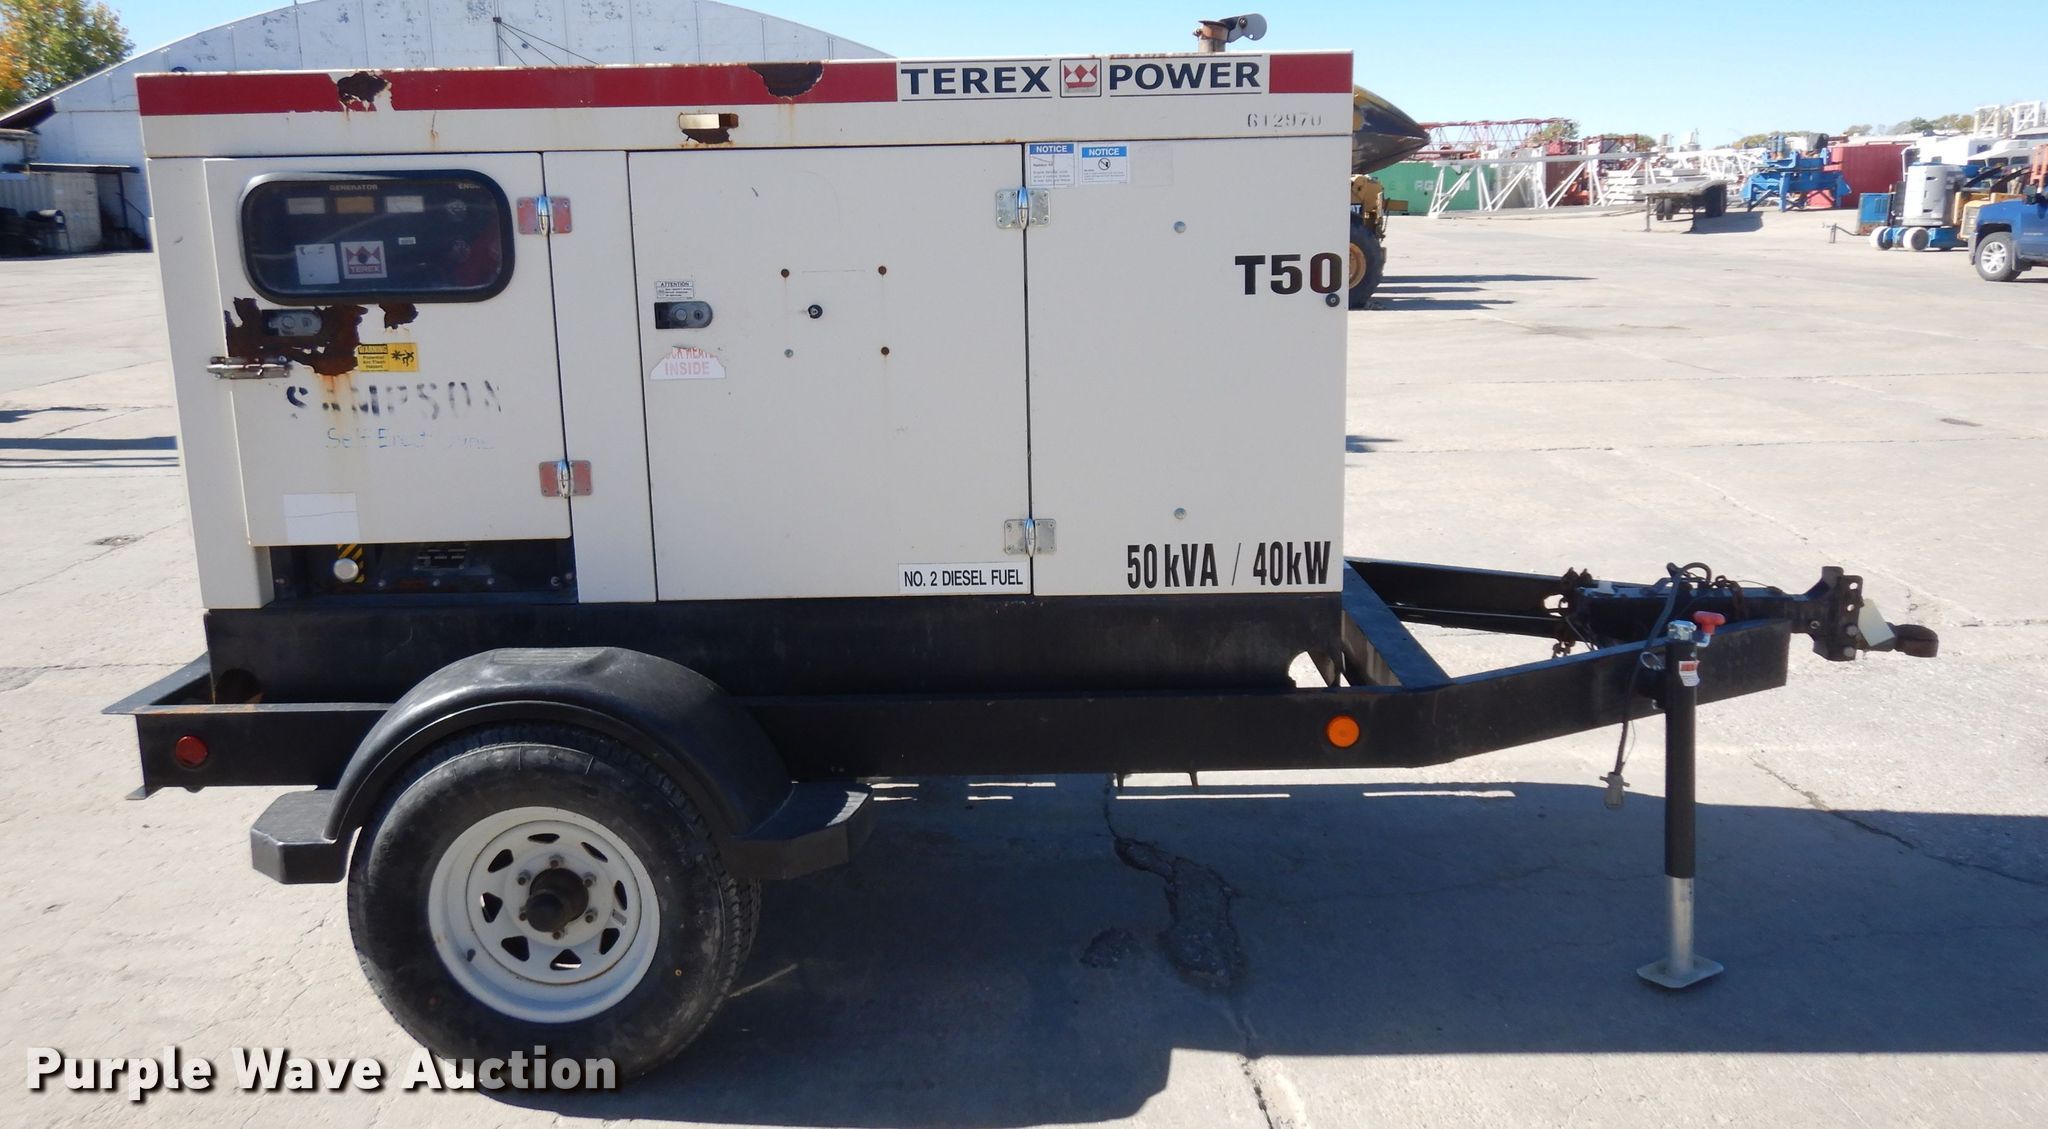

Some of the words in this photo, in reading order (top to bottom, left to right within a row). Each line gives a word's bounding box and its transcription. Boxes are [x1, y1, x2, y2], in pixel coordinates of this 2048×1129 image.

[901, 65, 1052, 95] TEREX
[1109, 61, 1261, 90] POWER
[1036, 144, 1068, 153] NOTICE
[1088, 147, 1120, 156] NOTICE
[349, 264, 381, 274] TEREX
[1234, 252, 1342, 295] T50
[665, 361, 711, 375] INSIDE
[1252, 541, 1331, 586] 40kW
[904, 571, 926, 587] NO.
[930, 571, 938, 586] 2
[942, 570, 987, 586] DIESEL
[991, 569, 1024, 585] FUEL
